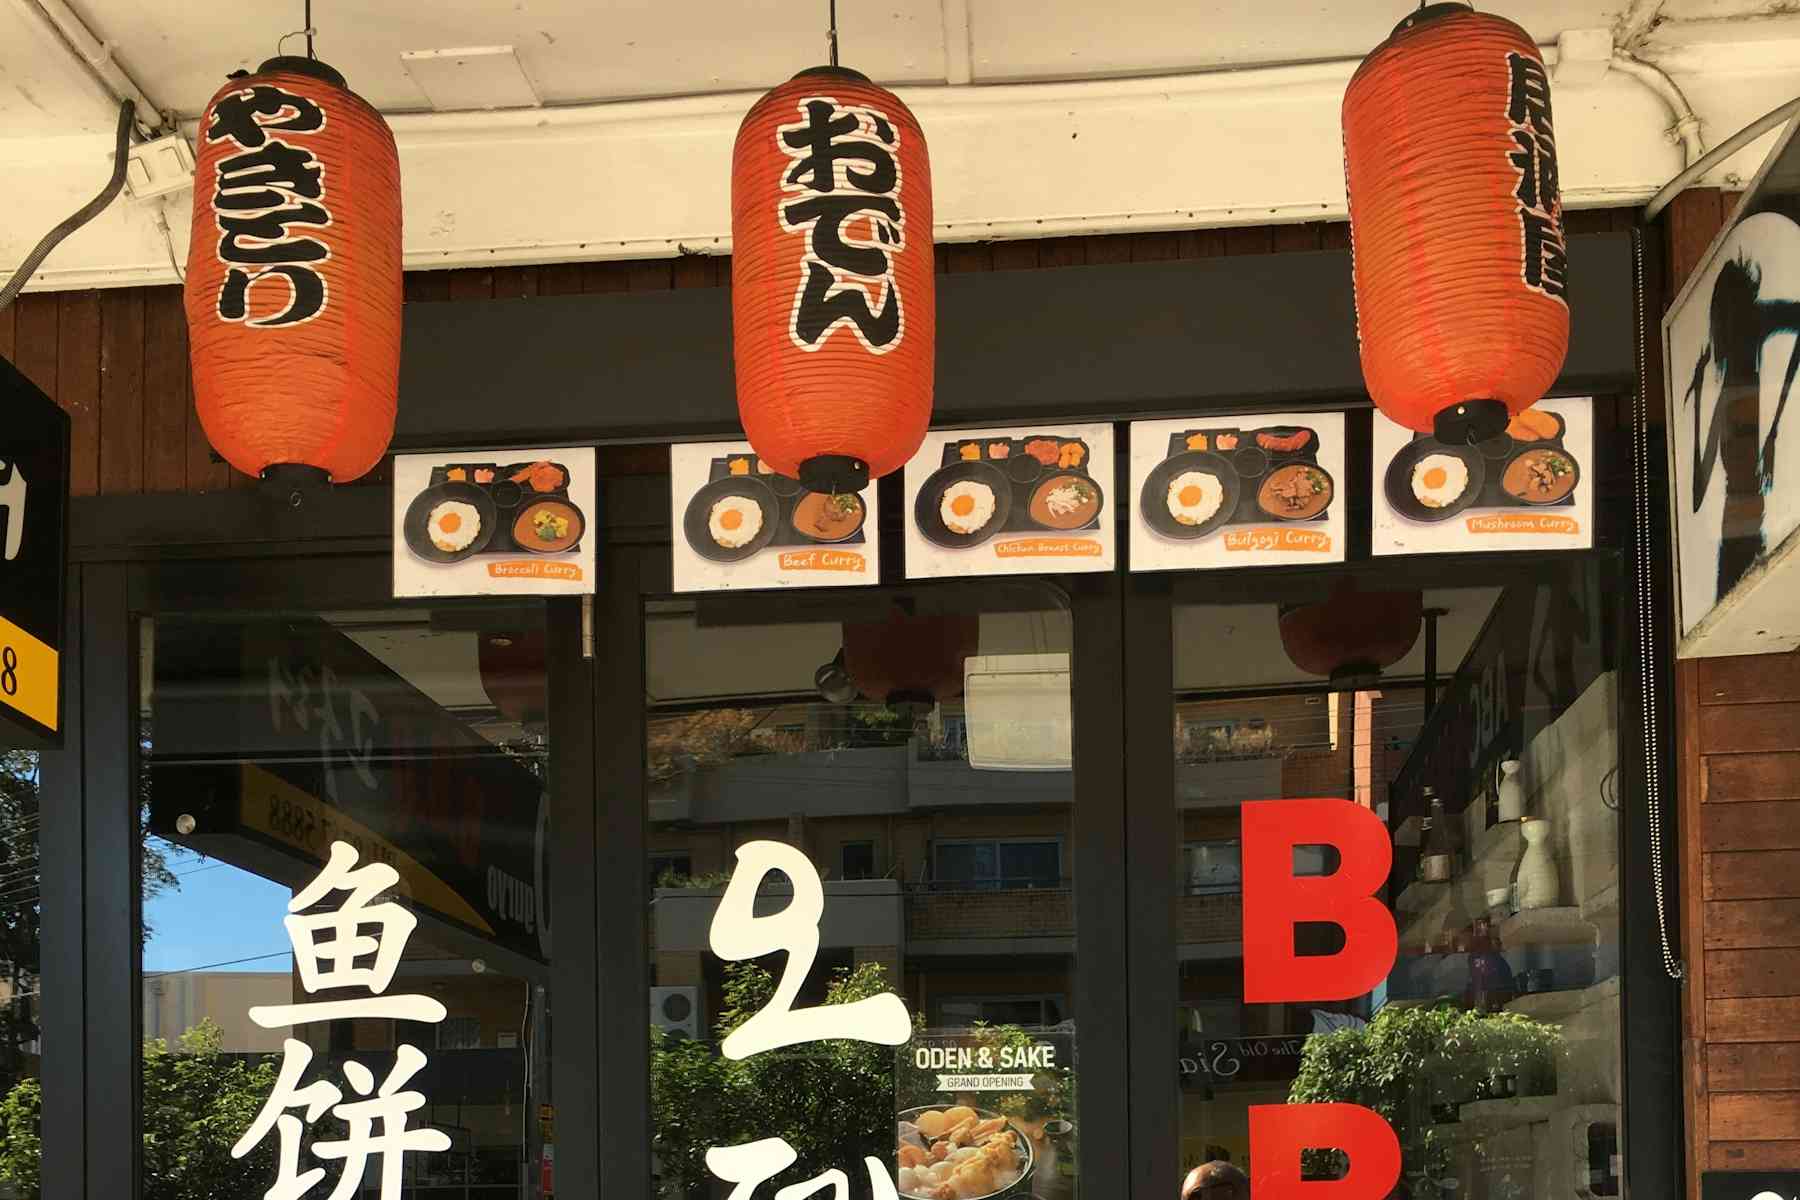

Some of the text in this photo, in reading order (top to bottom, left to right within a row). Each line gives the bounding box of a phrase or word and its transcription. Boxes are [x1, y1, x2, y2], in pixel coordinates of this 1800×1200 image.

[206, 84, 334, 329] やきとり
[775, 97, 905, 355] おでん
[1471, 517, 1575, 532] Mushroom Curry
[1072, 543, 1101, 555] Curry
[1227, 530, 1330, 550] Bulgogi Curry
[783, 552, 863, 570] Beef Curry
[543, 563, 578, 579] Curry
[915, 1045, 1056, 1069] ODEN & SAKE
[946, 1077, 1025, 1089] GRAND OPENING
